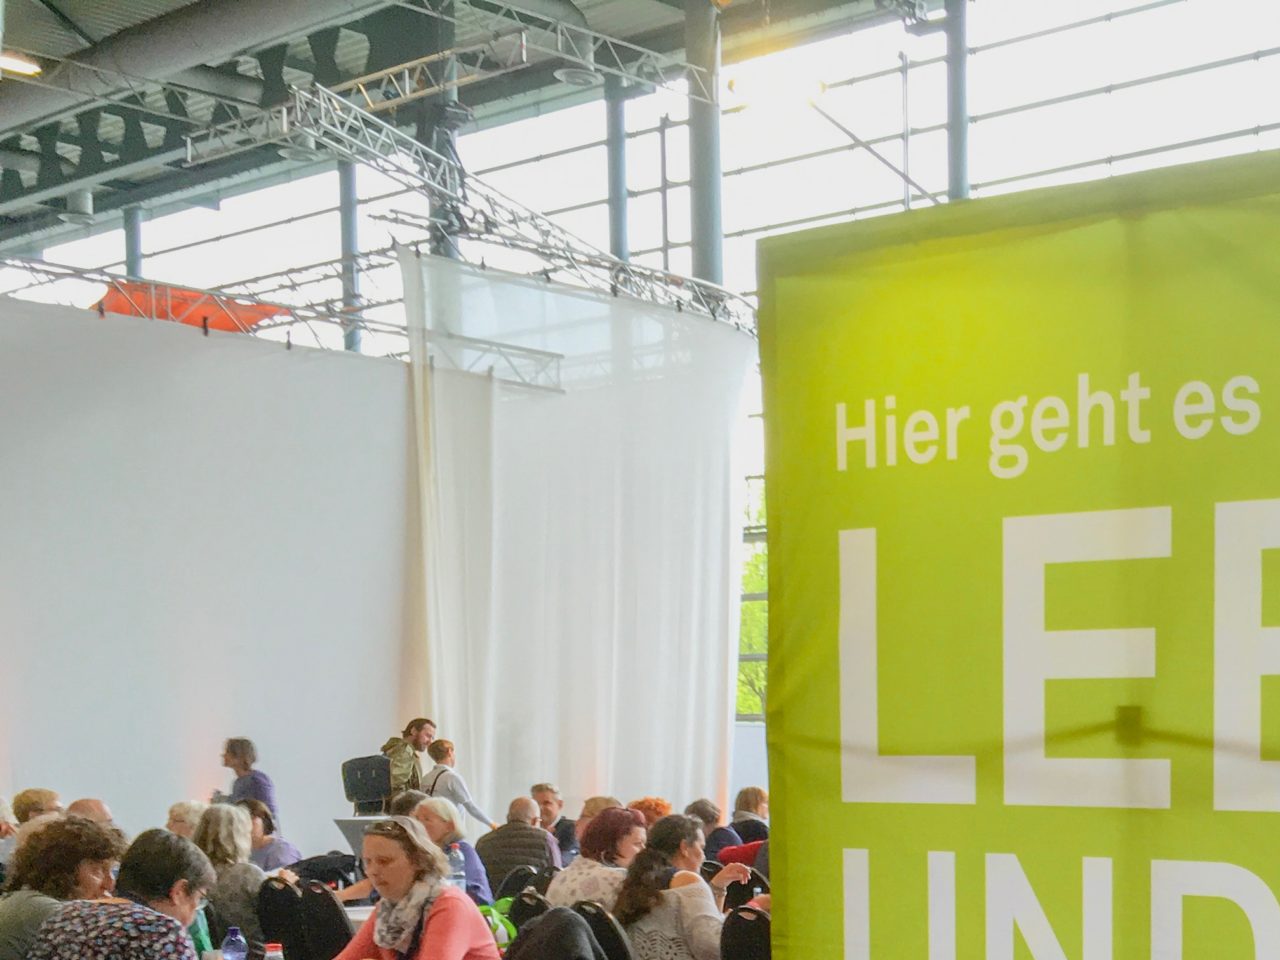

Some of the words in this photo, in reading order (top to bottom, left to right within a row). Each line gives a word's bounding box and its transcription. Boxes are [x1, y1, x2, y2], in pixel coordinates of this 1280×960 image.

[836, 396, 970, 471] Hier
[989, 372, 1151, 479] geht
[1173, 375, 1261, 440] es
